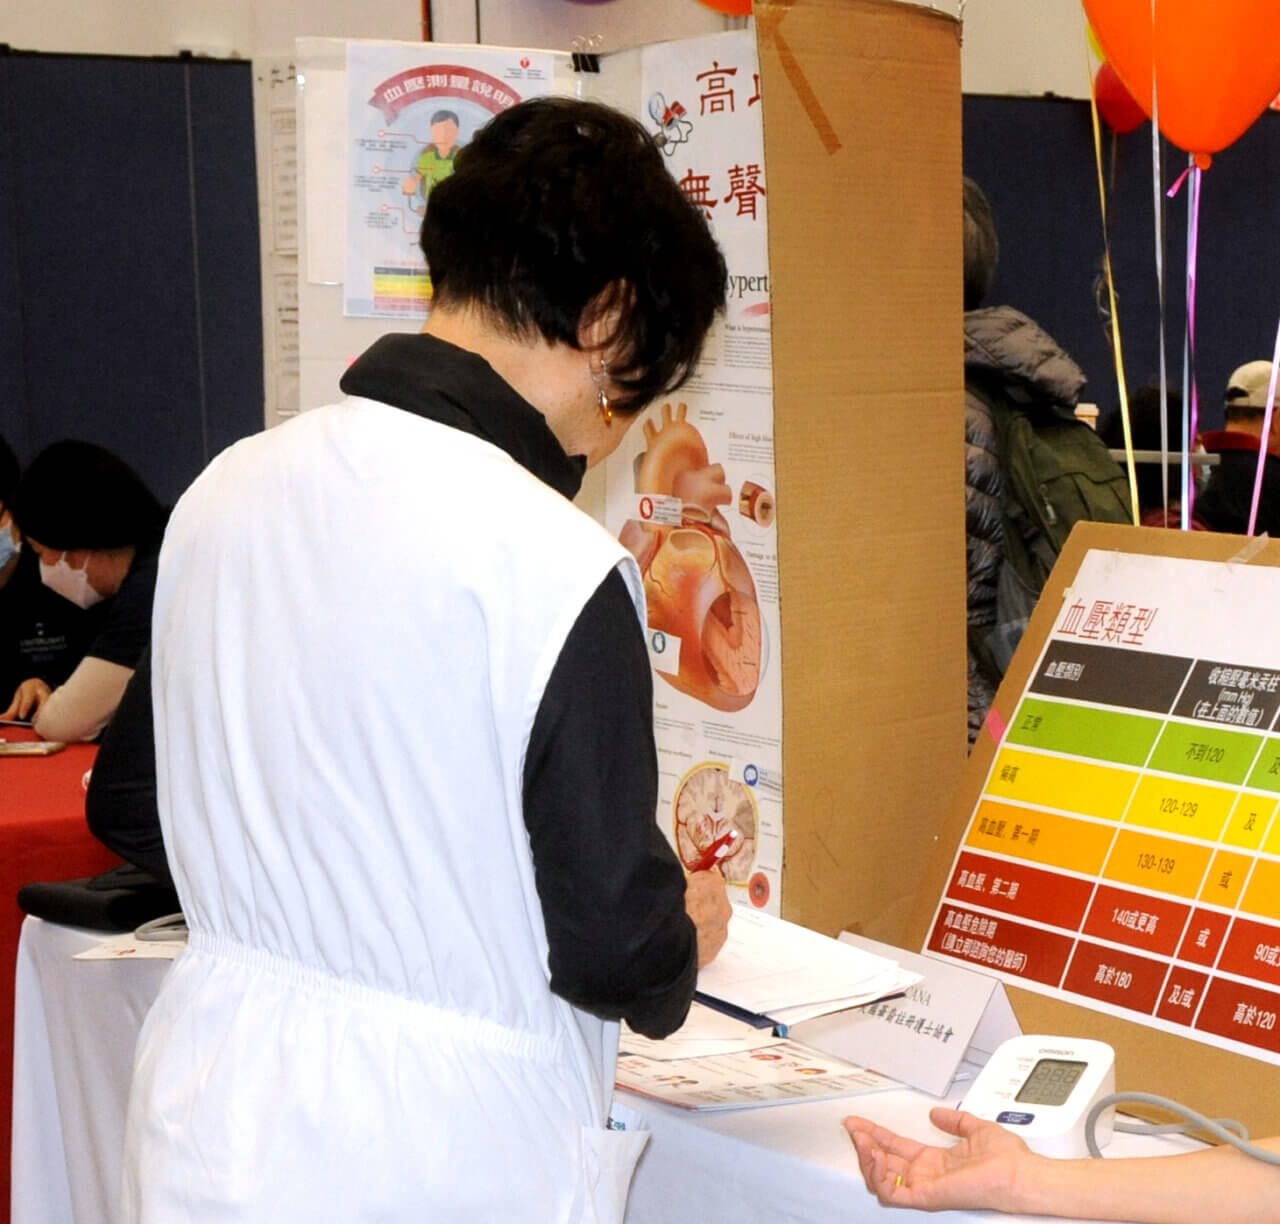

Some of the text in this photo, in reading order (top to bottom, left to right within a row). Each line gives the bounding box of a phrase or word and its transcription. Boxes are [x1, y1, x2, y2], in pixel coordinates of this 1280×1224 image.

[696, 61, 760, 117] 高
[725, 274, 768, 299] ypert
[1057, 598, 1159, 646] 血壓類型
[1186, 743, 1224, 763] 不到120
[1160, 797, 1199, 818] 120-129
[1243, 812, 1257, 831] 及
[1137, 853, 1175, 874] 130-139
[1218, 870, 1233, 889] 或
[1112, 908, 1159, 936] 140或更高
[1195, 928, 1211, 948] 或
[1094, 964, 1133, 990] 高於180
[1167, 985, 1196, 1009] 及/或
[1233, 1002, 1277, 1030] 高於120
